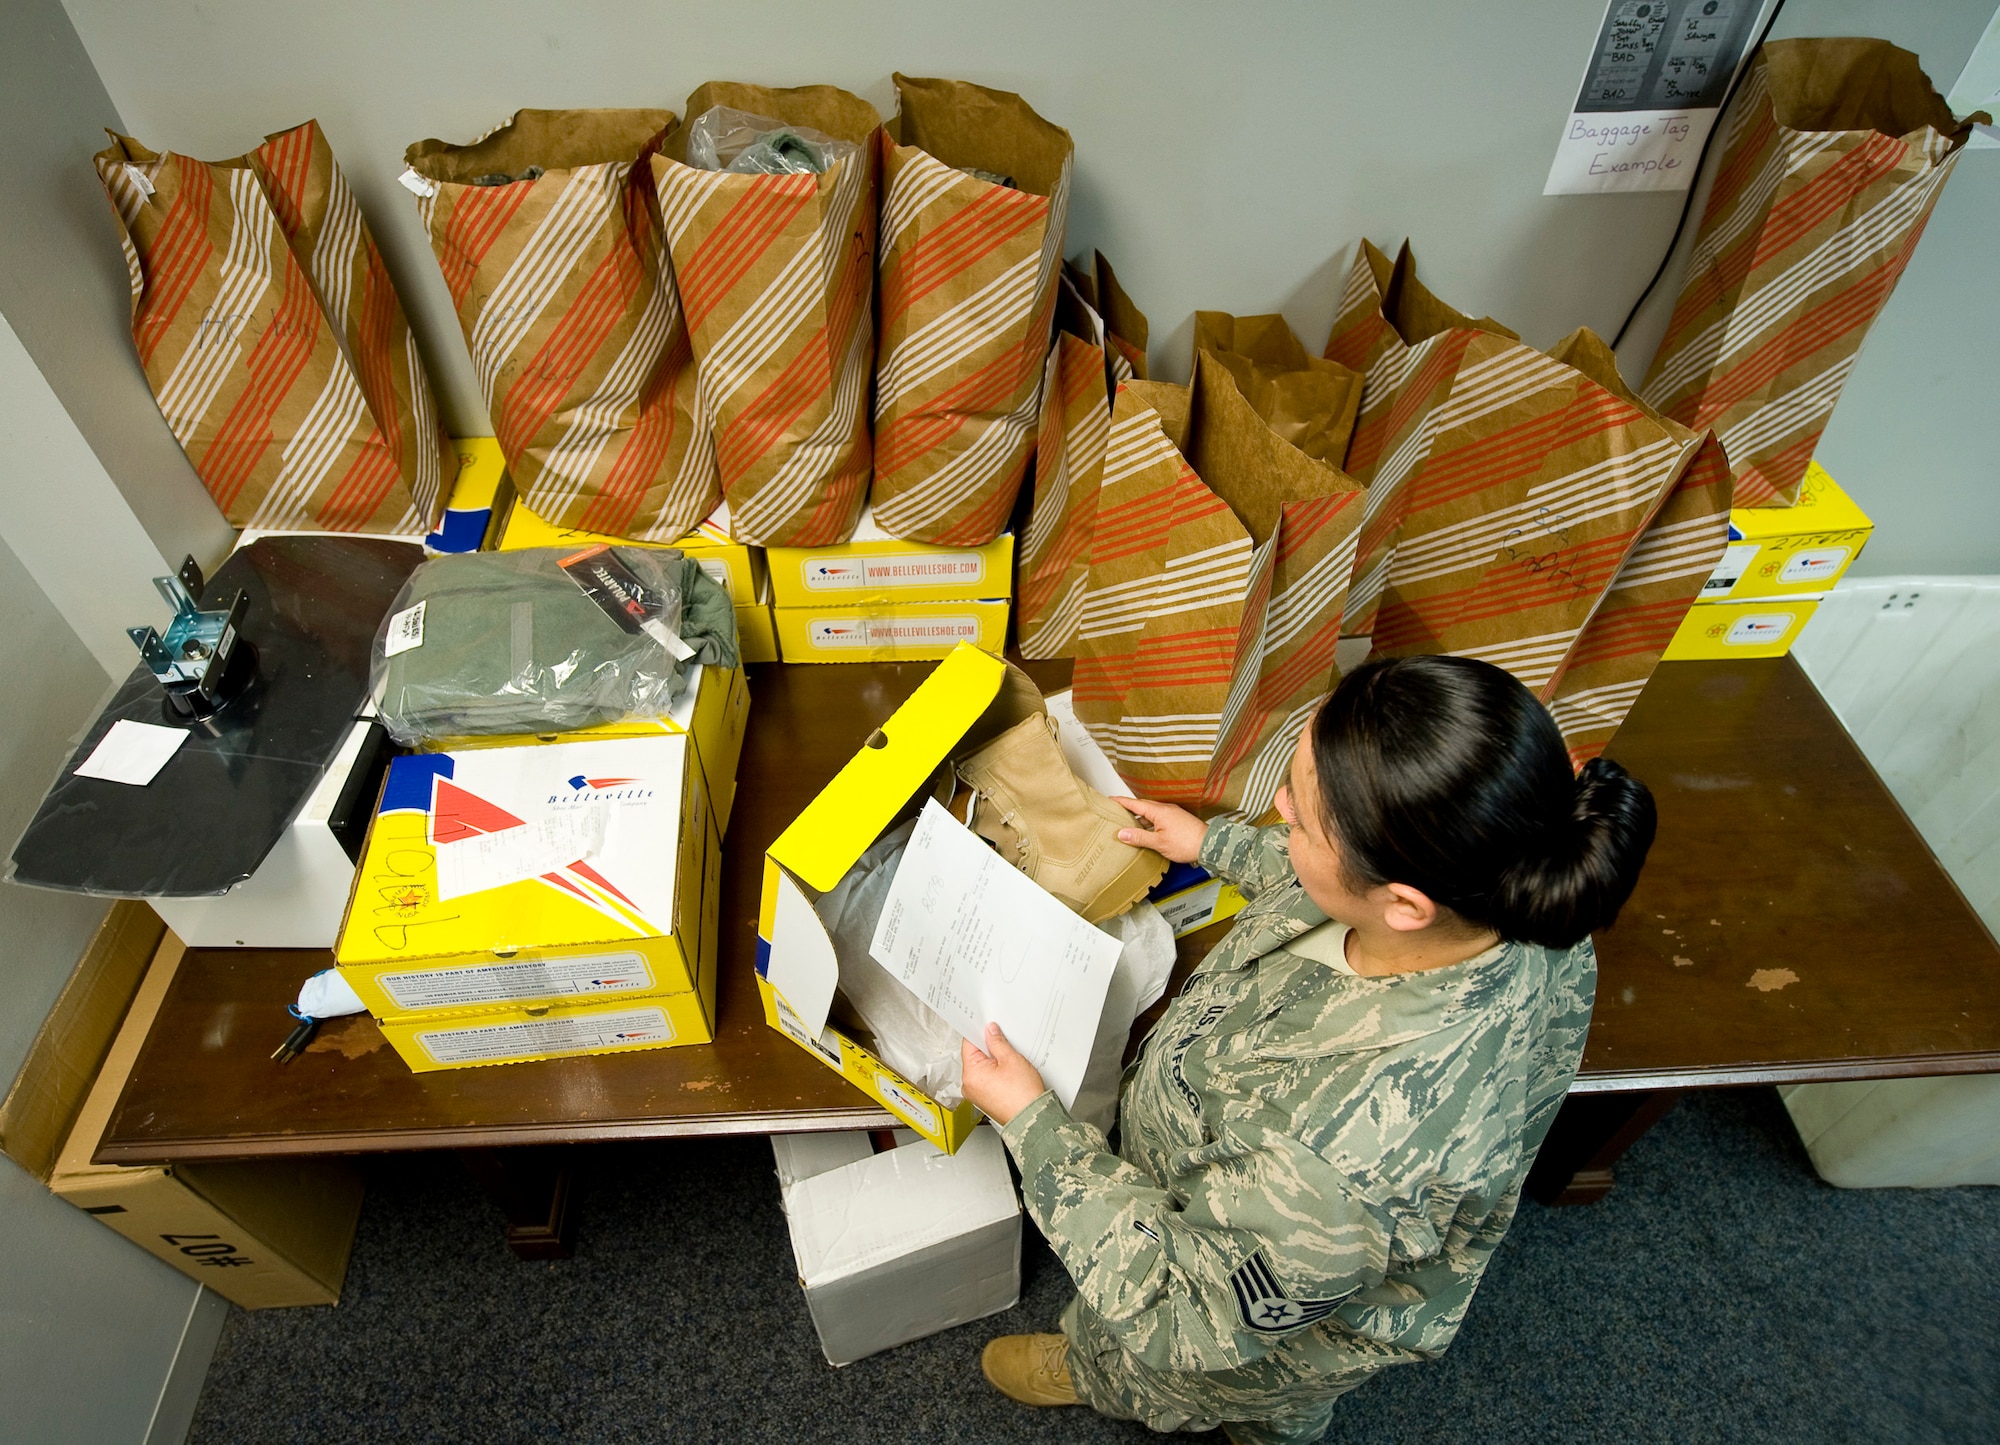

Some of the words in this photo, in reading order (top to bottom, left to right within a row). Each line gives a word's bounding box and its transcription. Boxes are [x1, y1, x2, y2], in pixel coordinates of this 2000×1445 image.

[1612, 53, 1635, 62] BAD
[1602, 89, 1625, 99] BAD
[1569, 119, 1651, 146] Baggage
[1659, 116, 1690, 142] Tag
[1589, 152, 1682, 176] Example
[868, 562, 978, 578] WWW.BELLEVILLESHOE.COM
[592, 567, 632, 603] POLARTEC
[870, 625, 975, 639] WWW.BELLEVILLESHOE.COM
[547, 789, 654, 805] Belleville
[1075, 844, 1105, 887] BELLEVILLE
[1171, 1054, 1201, 1118] FORCE
